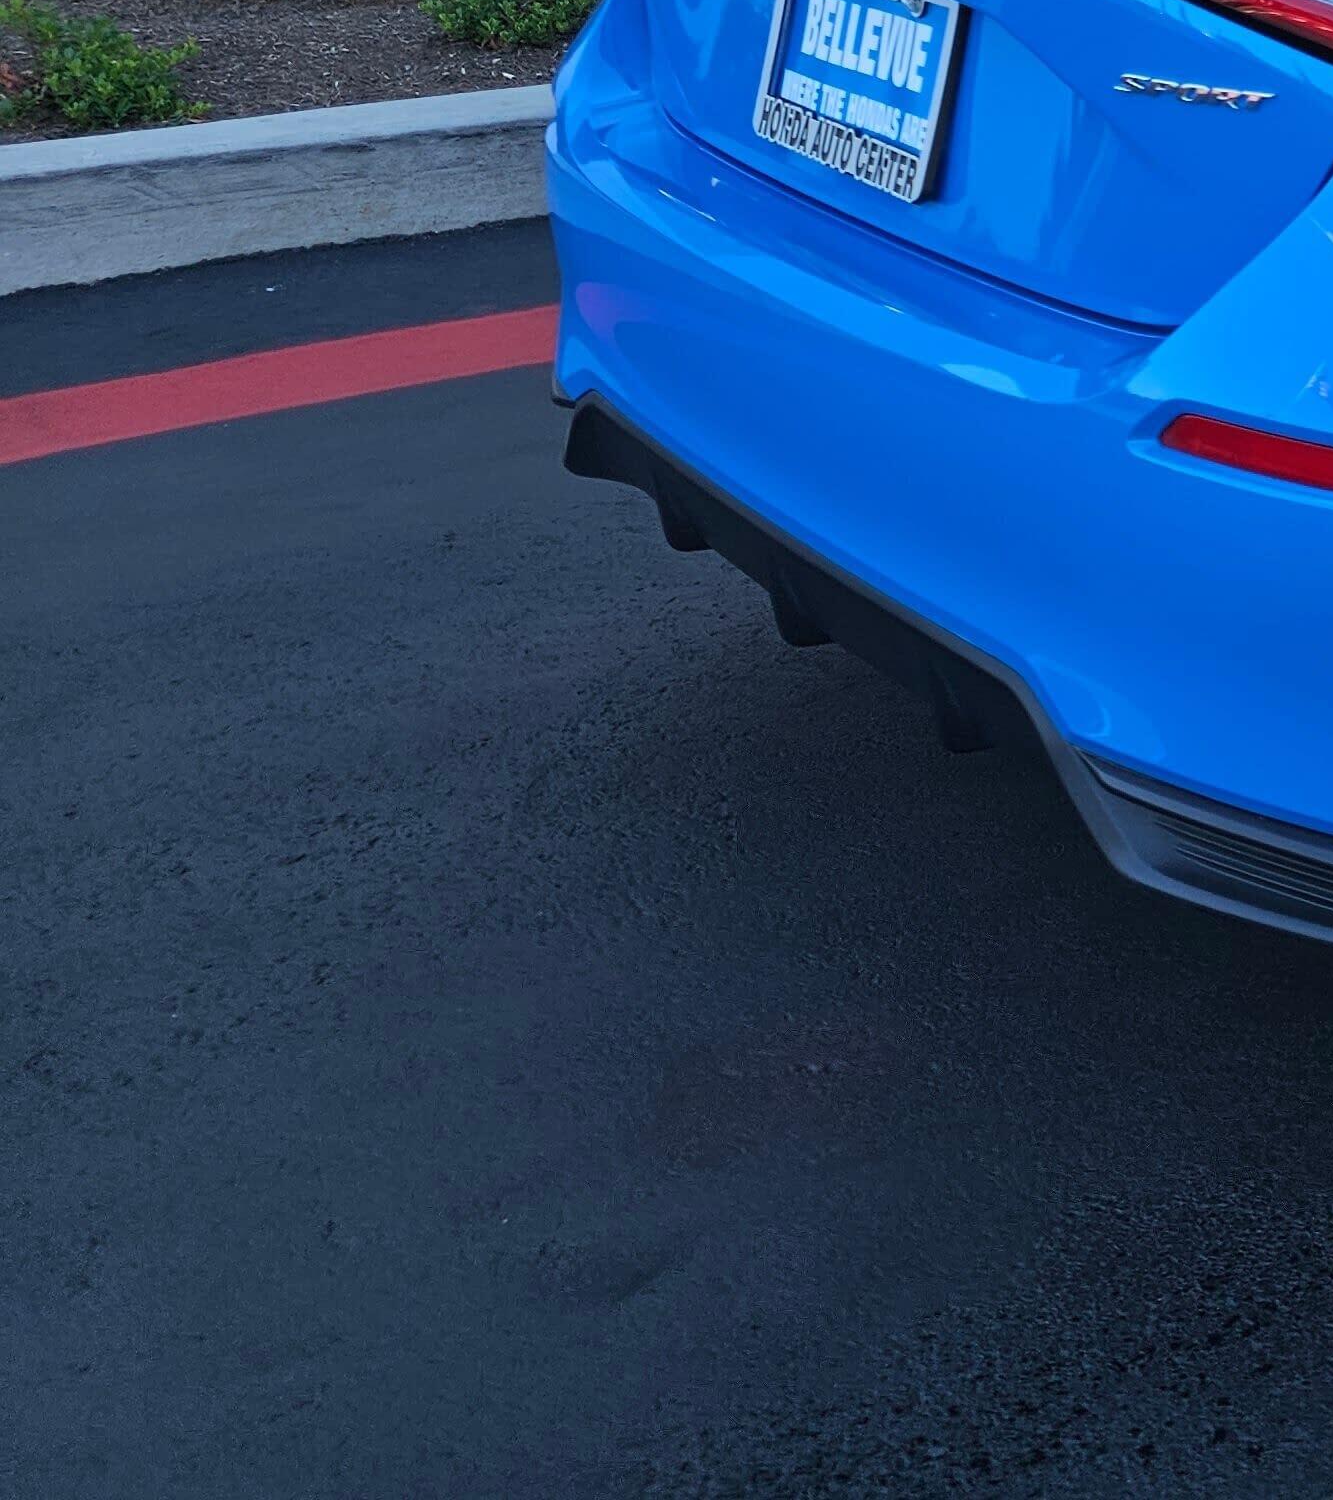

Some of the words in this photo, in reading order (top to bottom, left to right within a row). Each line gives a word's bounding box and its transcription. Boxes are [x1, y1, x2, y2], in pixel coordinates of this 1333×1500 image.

[820, 83, 847, 120] THE
[846, 92, 902, 141] HONDAS
[1113, 73, 1276, 111] SPORT
[758, 98, 810, 154] HONDA
[811, 117, 853, 171] AUTO
[854, 136, 920, 199] CENTER
